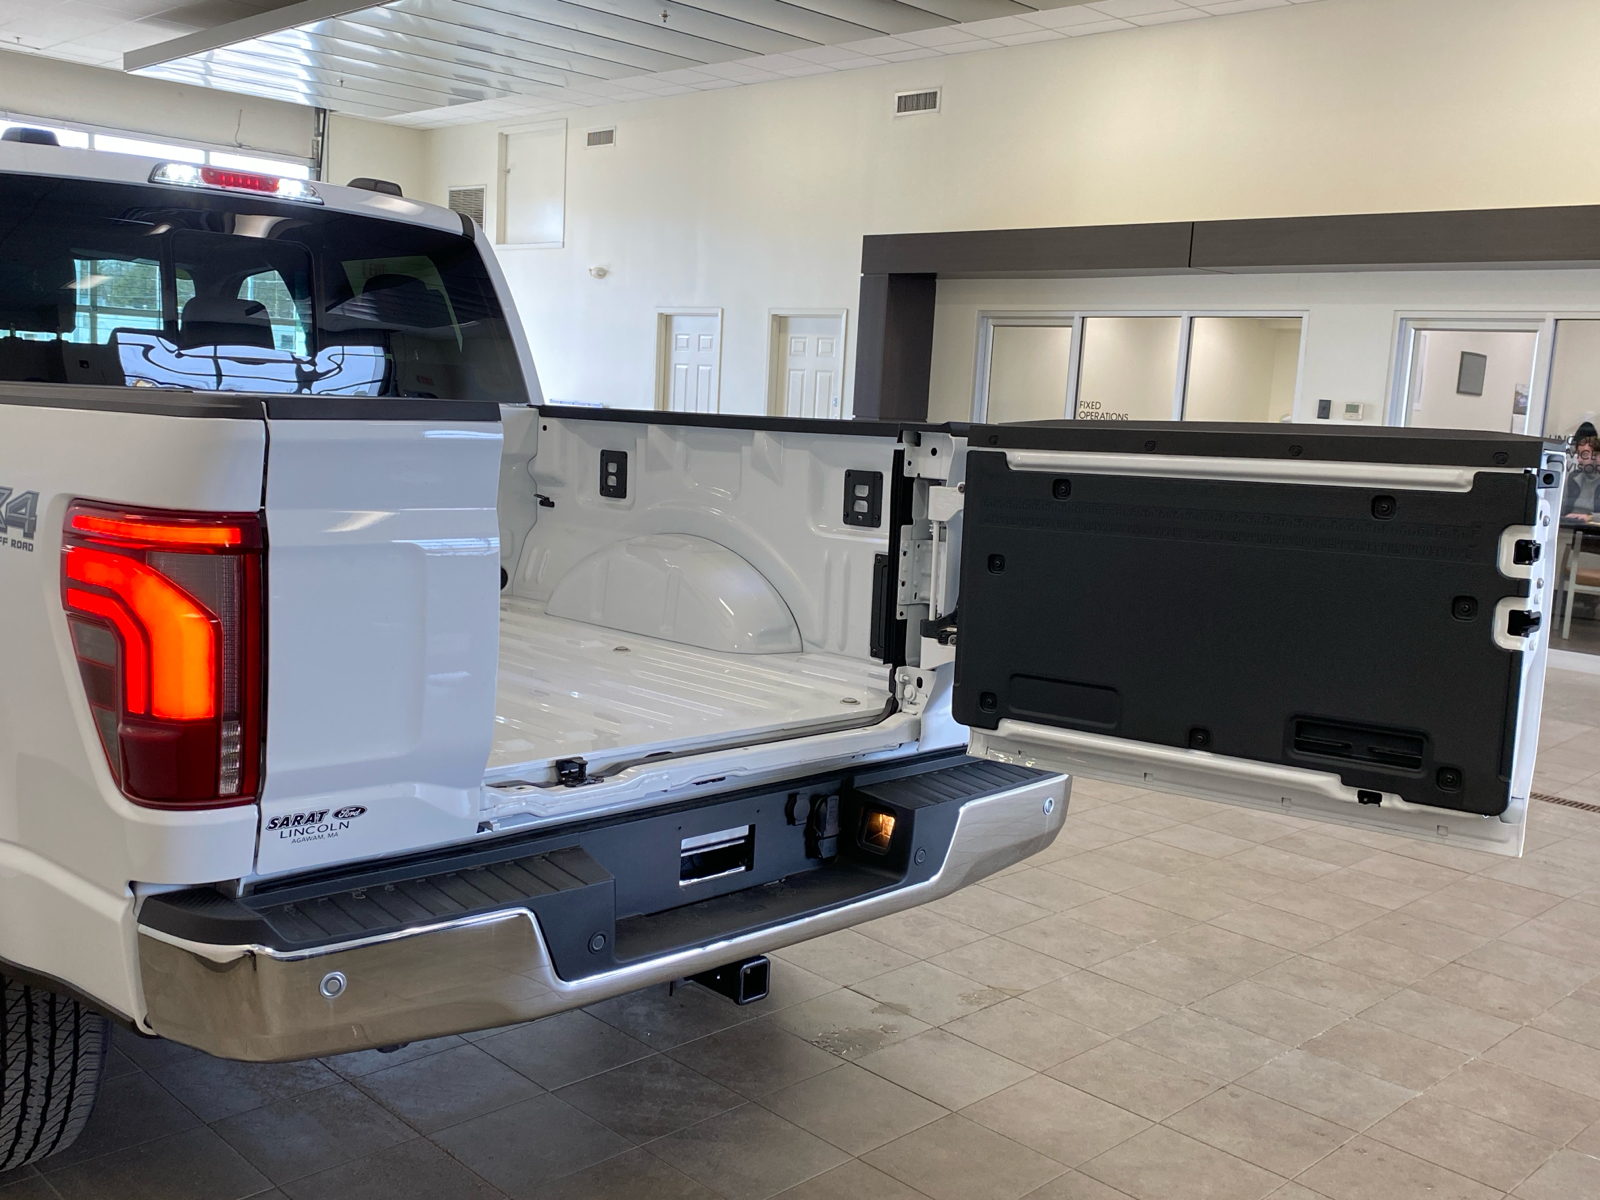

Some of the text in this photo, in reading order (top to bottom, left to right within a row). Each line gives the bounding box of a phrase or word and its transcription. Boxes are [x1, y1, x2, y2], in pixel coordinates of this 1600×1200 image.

[1079, 401, 1101, 410] FIXED
[1079, 411, 1129, 420] OPERATIONS
[11, 539, 34, 552] ROAD
[266, 806, 364, 831] SARAT Ford
[280, 821, 350, 839] LINCOLN
[291, 834, 325, 844] AGAWAM,
